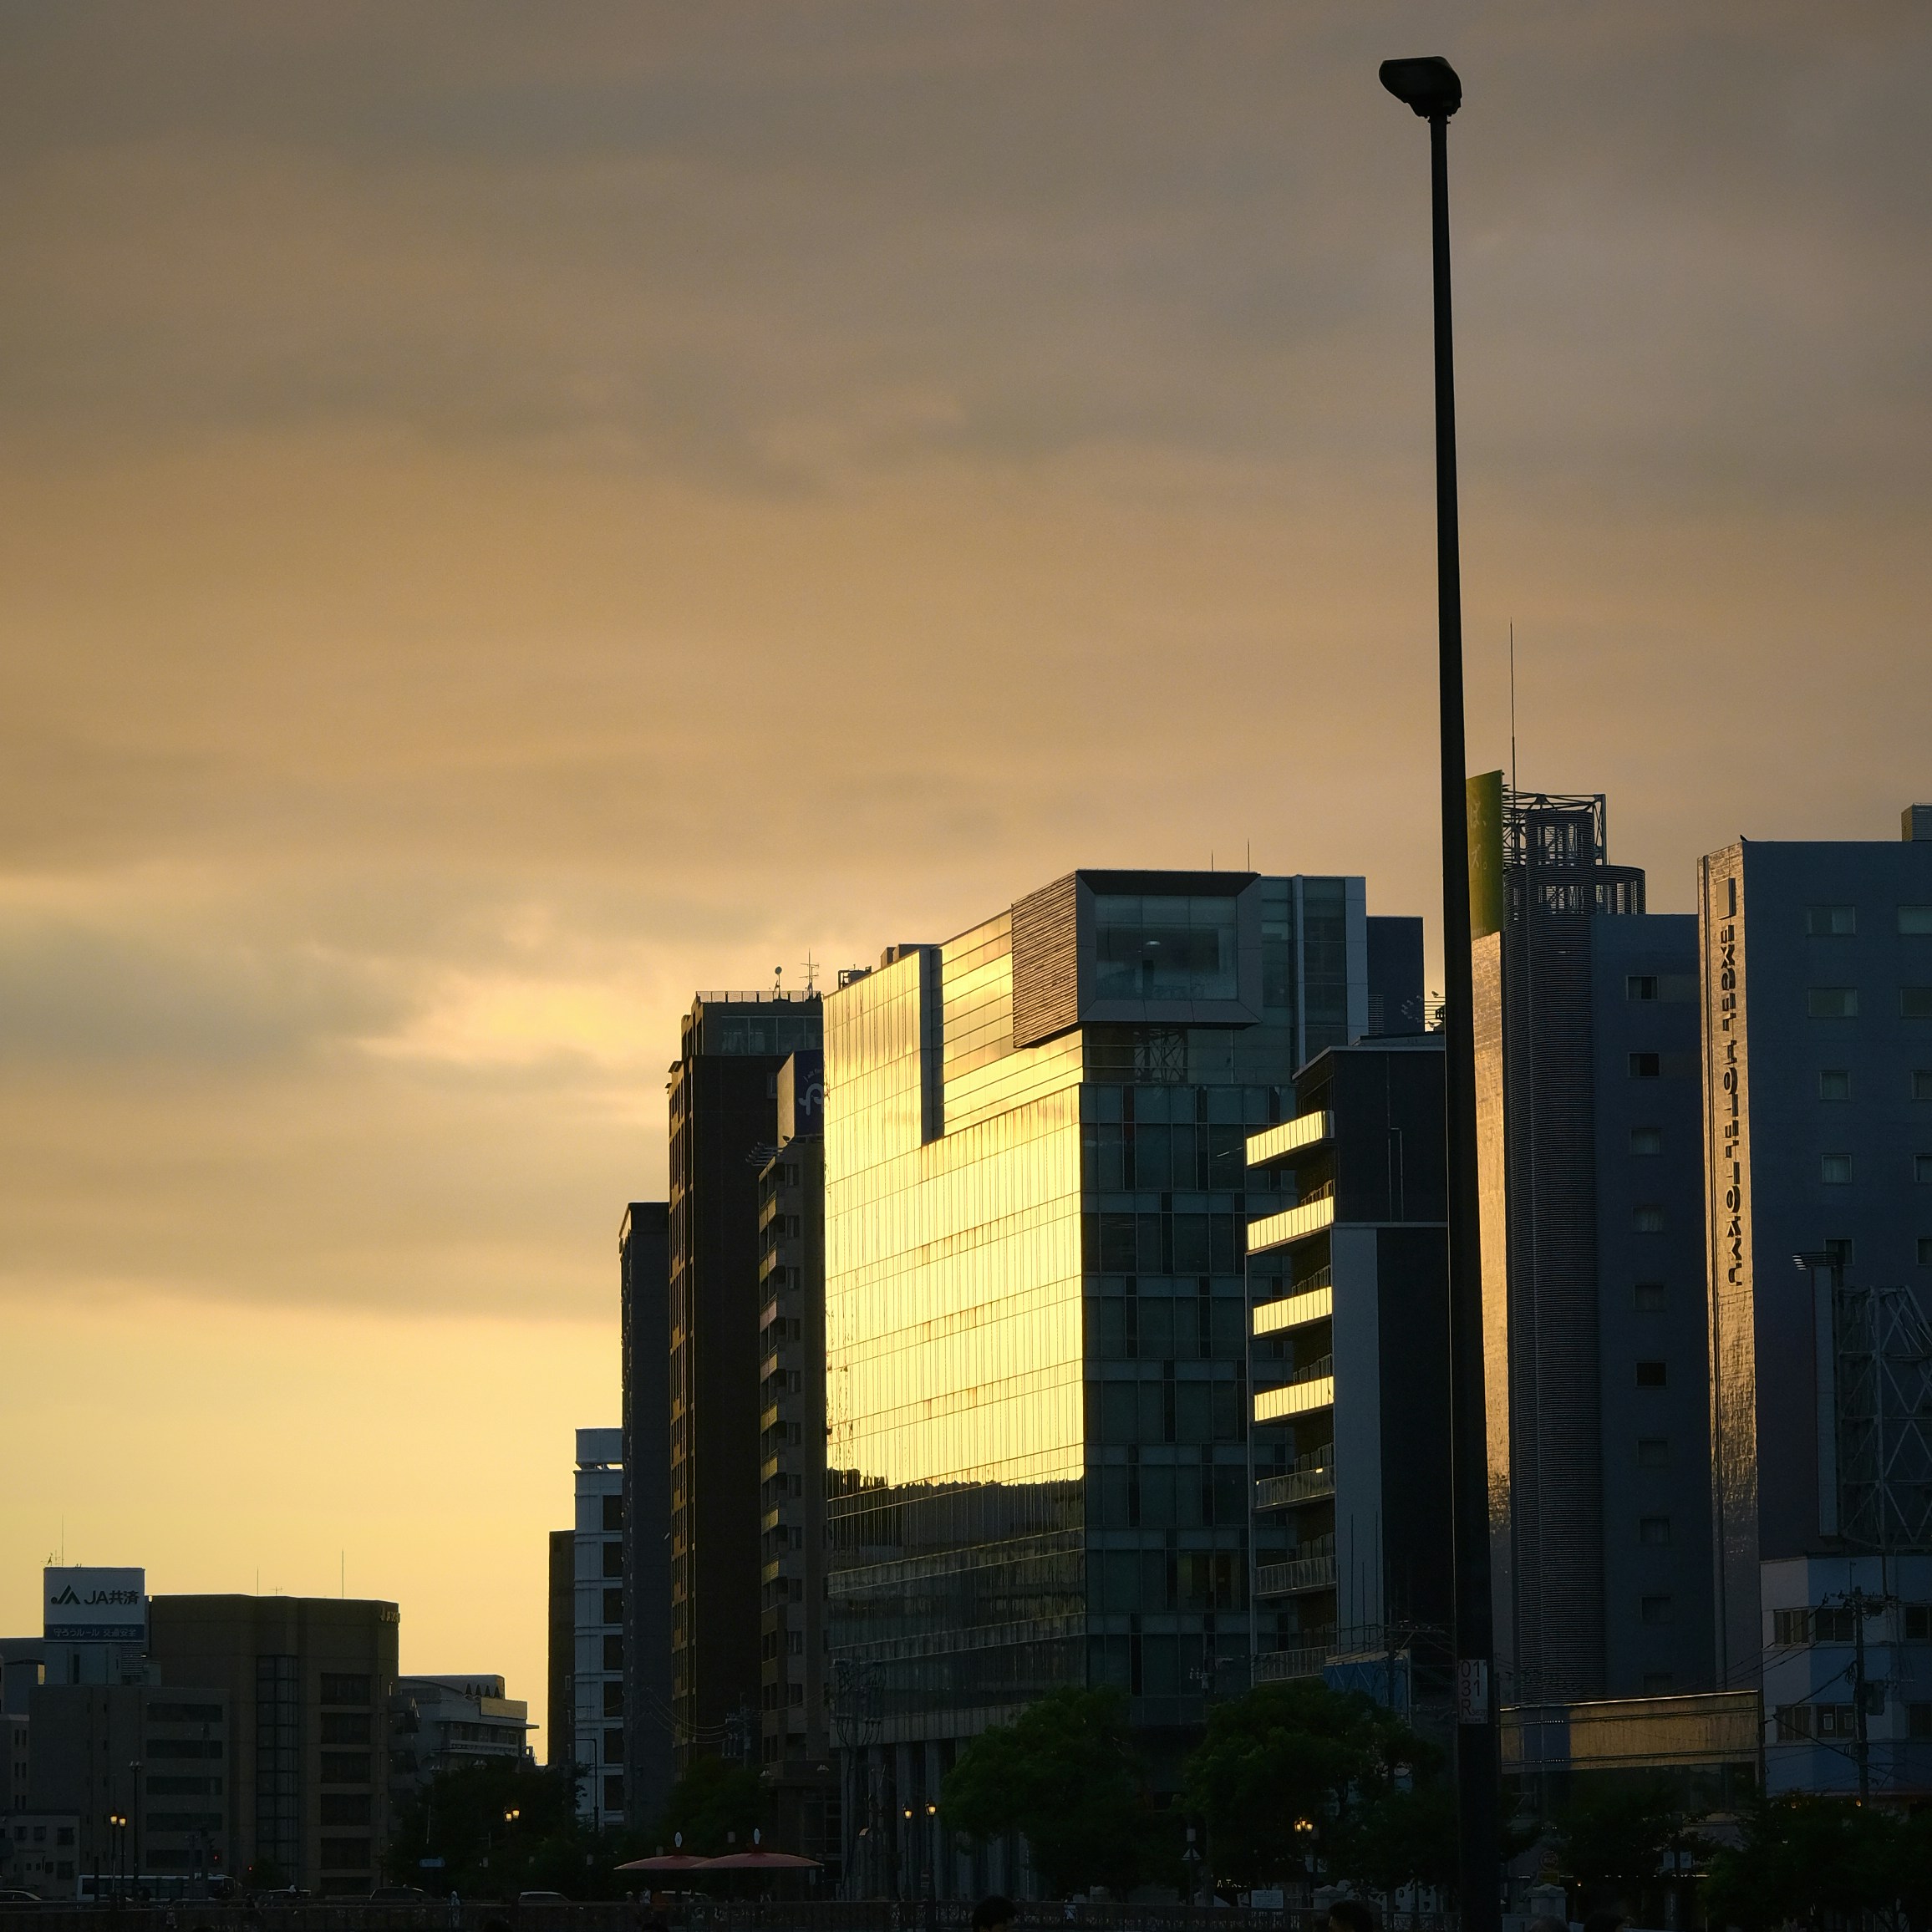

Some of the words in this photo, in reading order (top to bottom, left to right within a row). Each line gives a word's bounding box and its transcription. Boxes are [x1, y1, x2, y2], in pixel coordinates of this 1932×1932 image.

[1720, 924, 1736, 1032] EXCEL
[1723, 1040, 1740, 1159] HOTEL
[1726, 1161, 1743, 1288] TOKYU
[84, 1589, 140, 1605] JA共済
[53, 1627, 99, 1638] 守ろうルール
[1461, 1660, 1480, 1678] 01
[1461, 1680, 1480, 1697] 31
